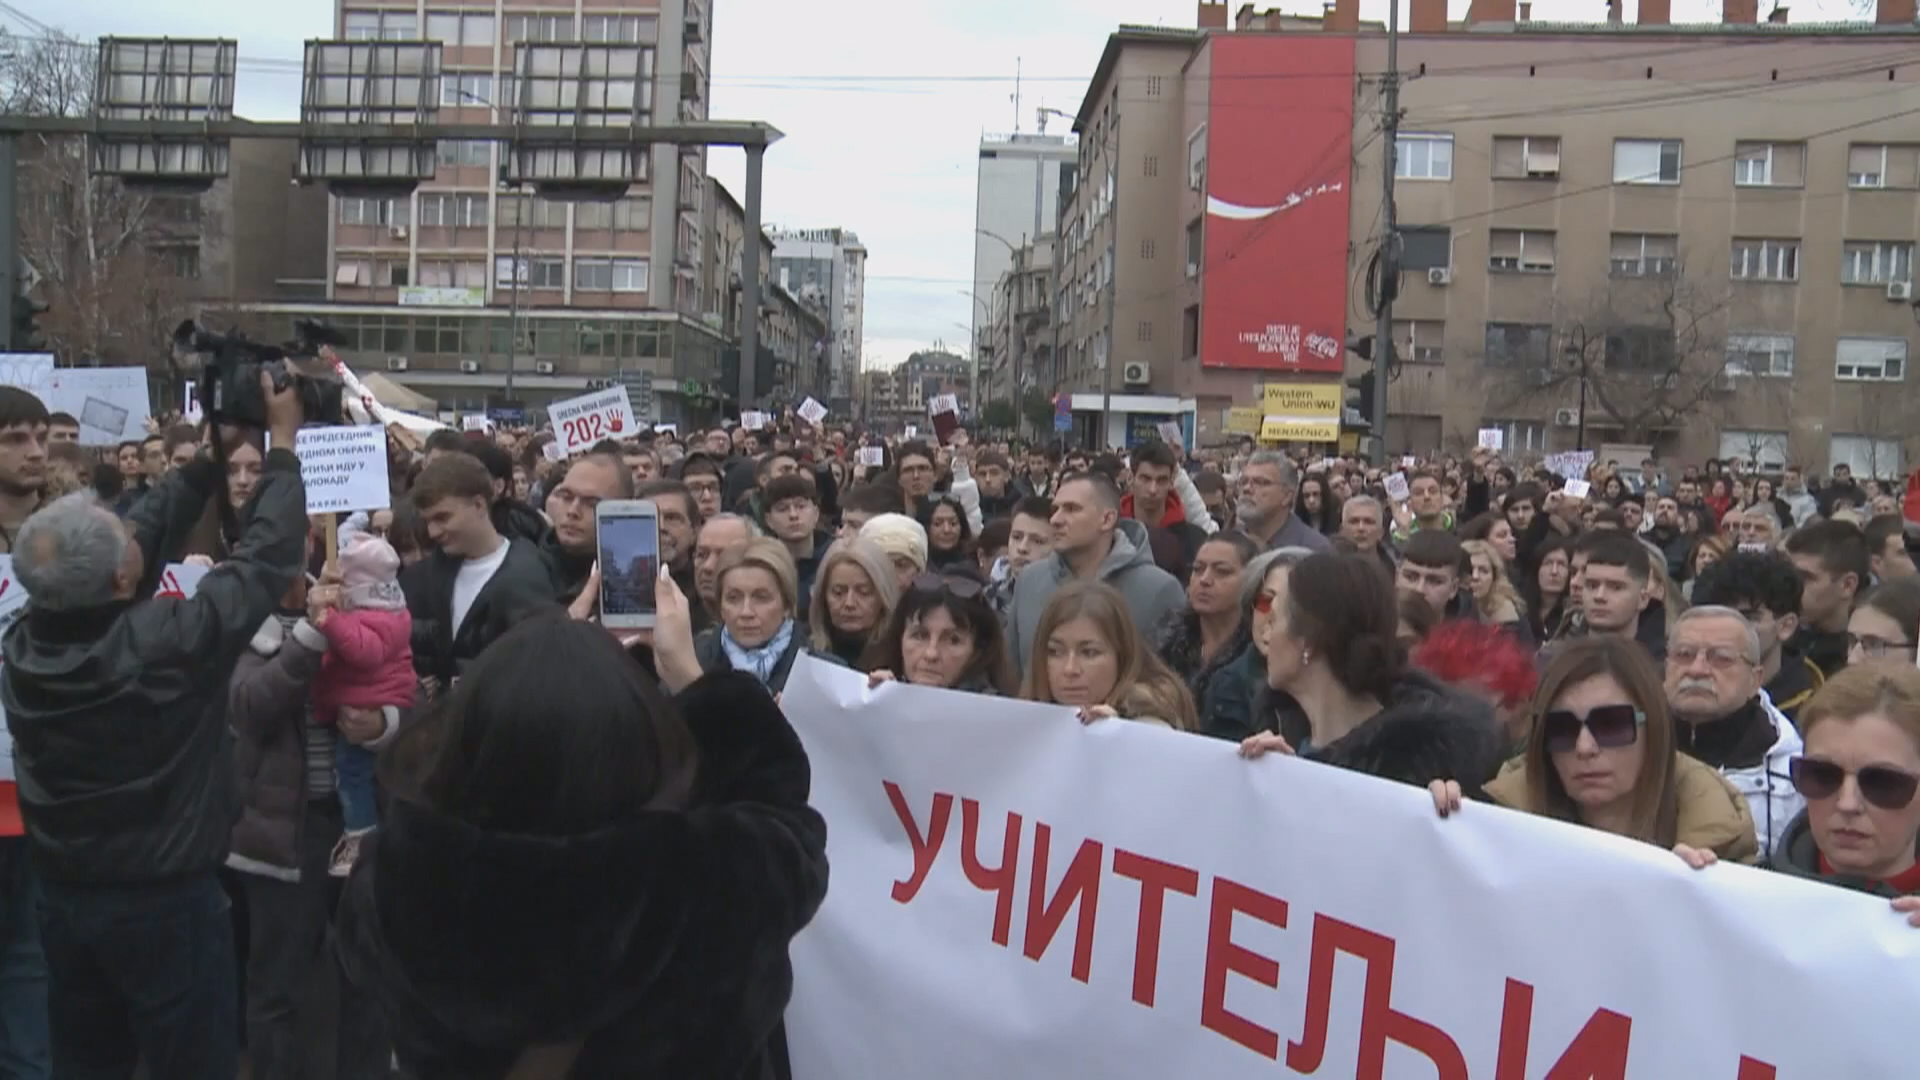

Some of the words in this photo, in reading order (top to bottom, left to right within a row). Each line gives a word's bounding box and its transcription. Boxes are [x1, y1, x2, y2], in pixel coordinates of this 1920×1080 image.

[1268, 388, 1313, 399] Western
[581, 402, 598, 411] NOVA
[1282, 400, 1313, 409] Union
[310, 432, 372, 443] ПРЕДСЕДНИК
[338, 445, 375, 455] ОБРАТИ
[302, 464, 334, 475] РТИЋИ
[336, 461, 357, 473] ИДУ
